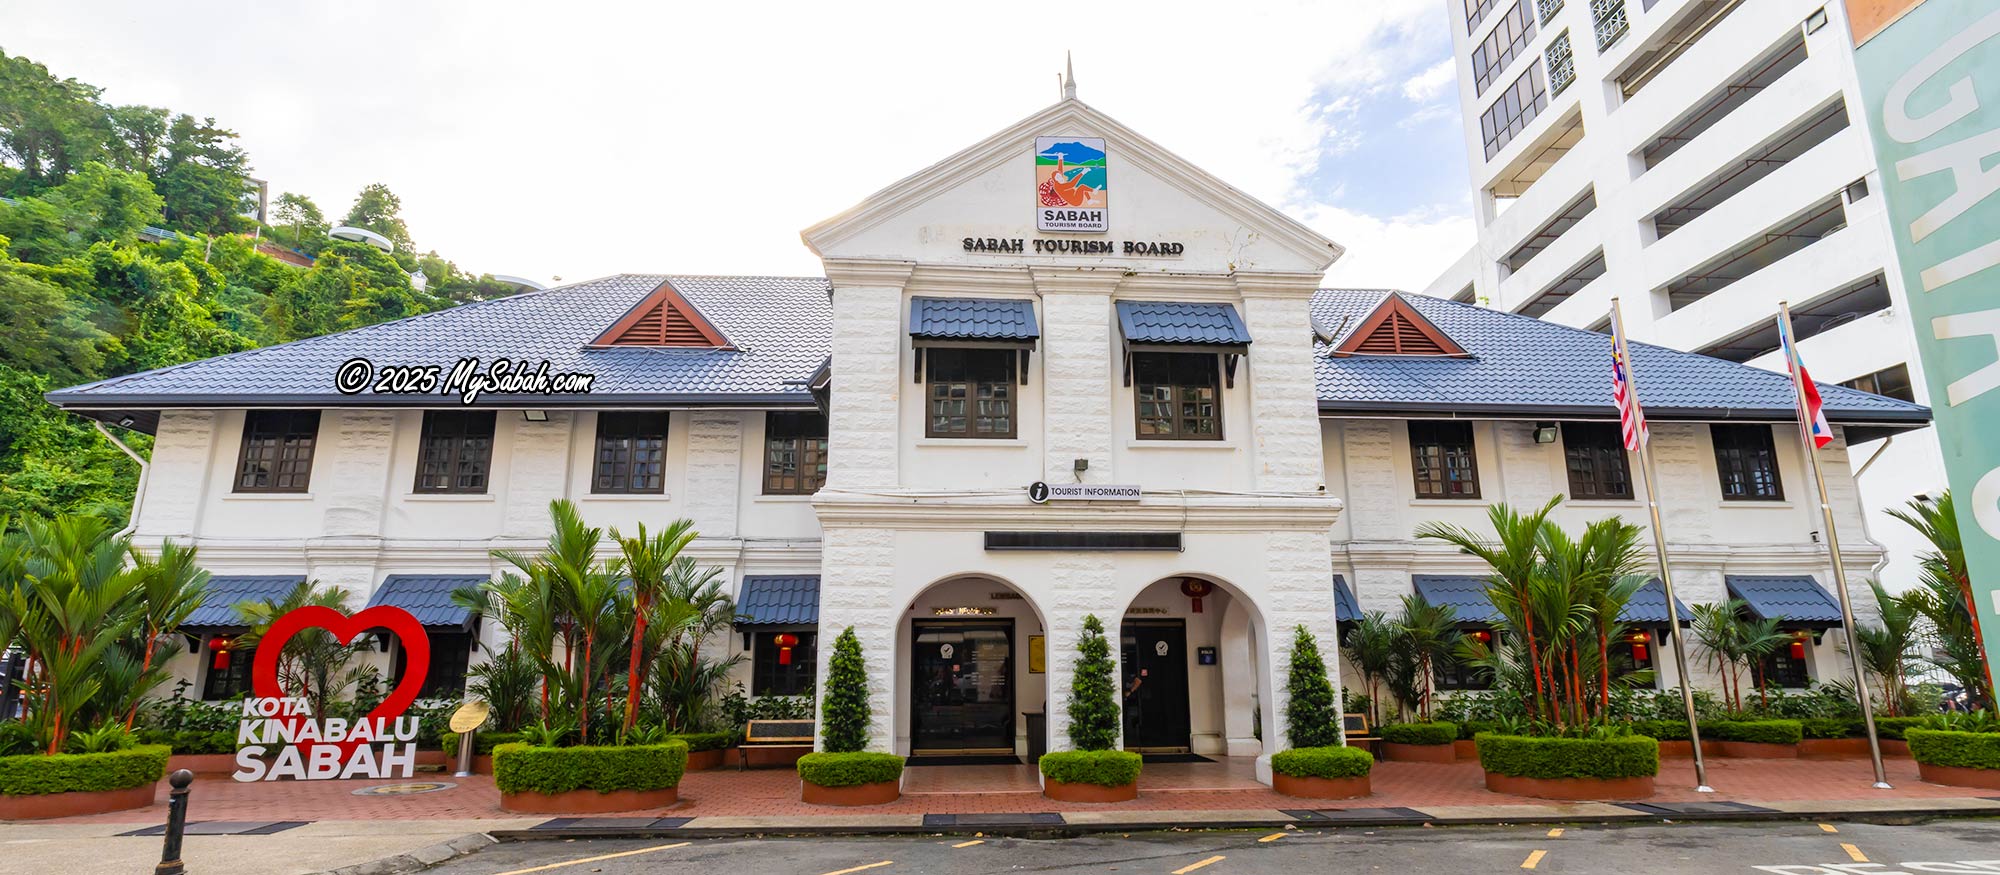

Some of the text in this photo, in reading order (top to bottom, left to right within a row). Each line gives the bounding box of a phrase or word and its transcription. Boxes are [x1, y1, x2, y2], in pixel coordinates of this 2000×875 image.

[1044, 210, 1102, 222] SABAH
[962, 237, 1184, 256] SABAH TOURISM BOARD
[1051, 487, 1082, 496] TOURIST
[1084, 488, 1140, 497] INFORMATION
[242, 697, 312, 717] KOTA
[238, 716, 420, 745] KINABALU
[232, 743, 417, 782] SABAH
